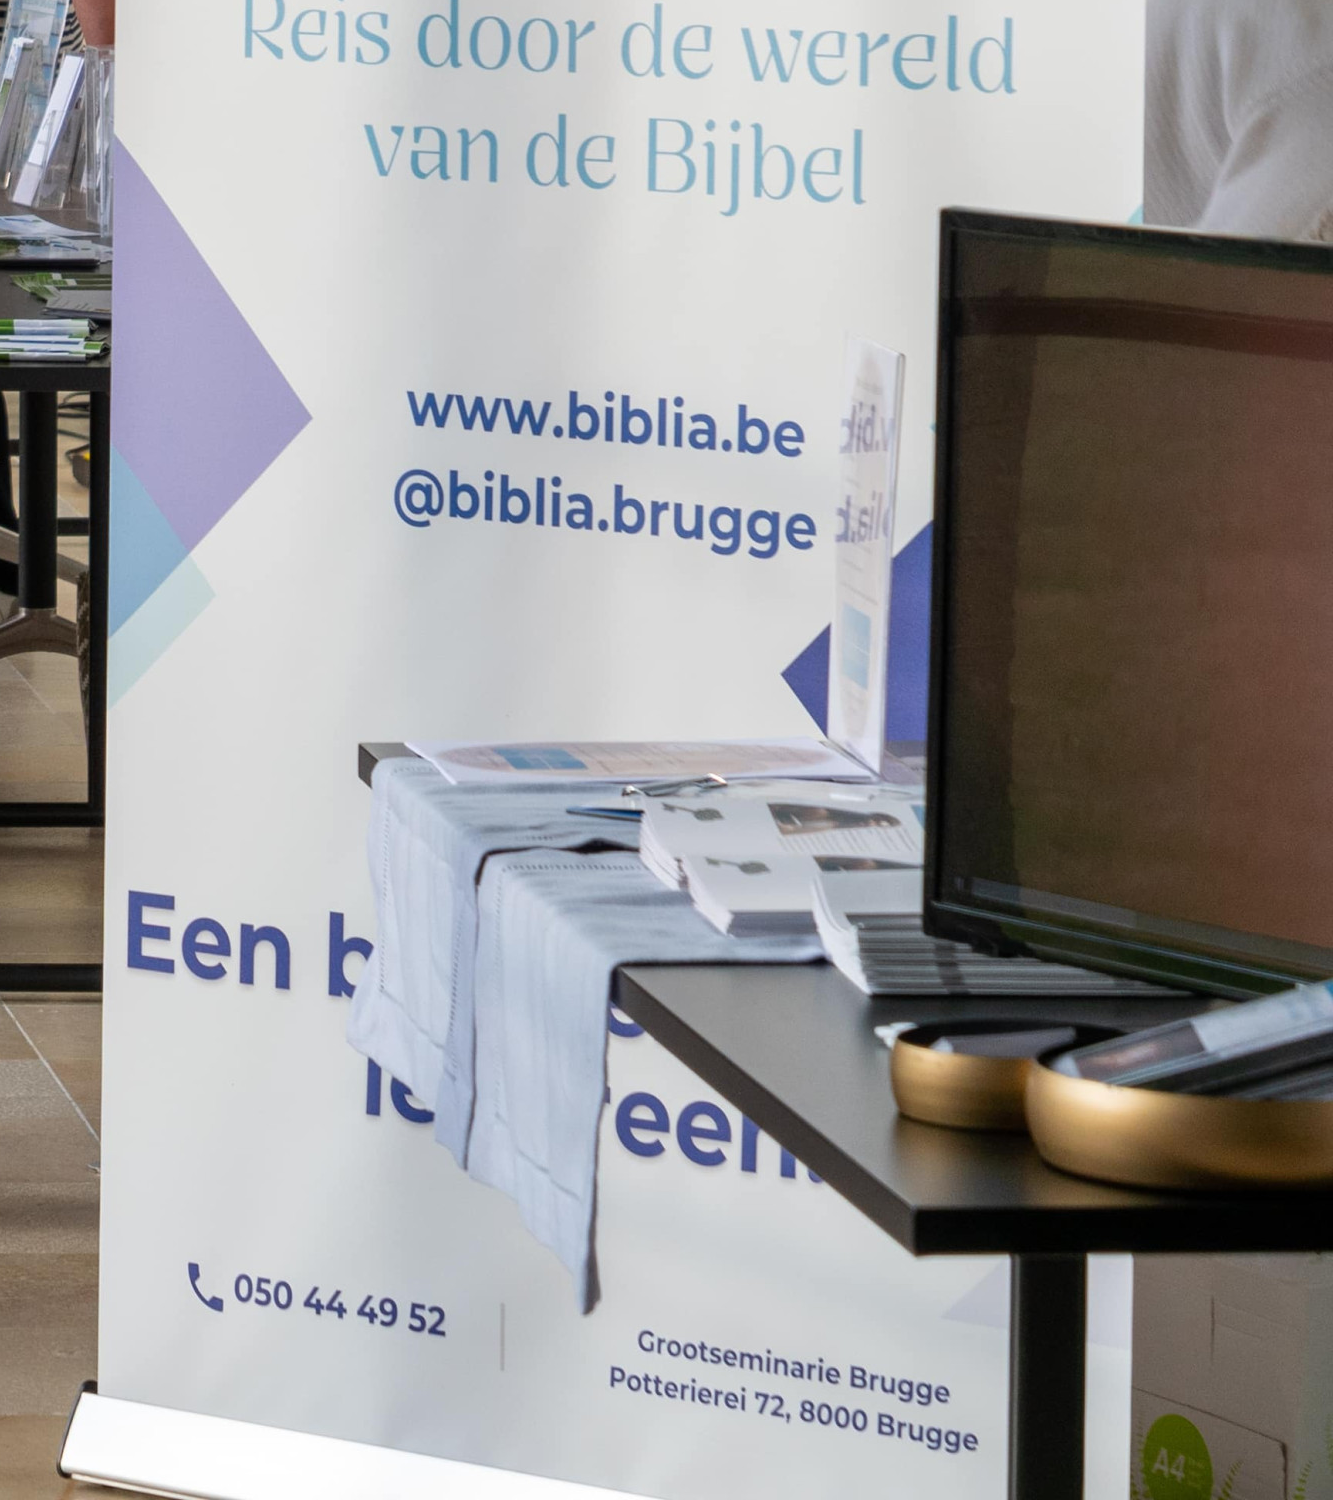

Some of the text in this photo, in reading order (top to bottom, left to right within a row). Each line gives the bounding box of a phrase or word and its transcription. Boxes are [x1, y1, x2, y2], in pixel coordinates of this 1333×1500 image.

[621, 2, 713, 80] de
[741, 14, 1015, 94] wereld
[364, 113, 866, 217] van de Bijbel
[407, 389, 805, 457] www.biblia.be
[394, 469, 816, 559] @biblia.brugge
[127, 891, 291, 990] Een
[234, 1274, 446, 1337] 050 44 49 52
[609, 1366, 979, 1454] Potterierei 72, 8000 Brugge
[637, 1330, 951, 1406] Grootseminarie Brugge
[1152, 1446, 1185, 1483] A4
